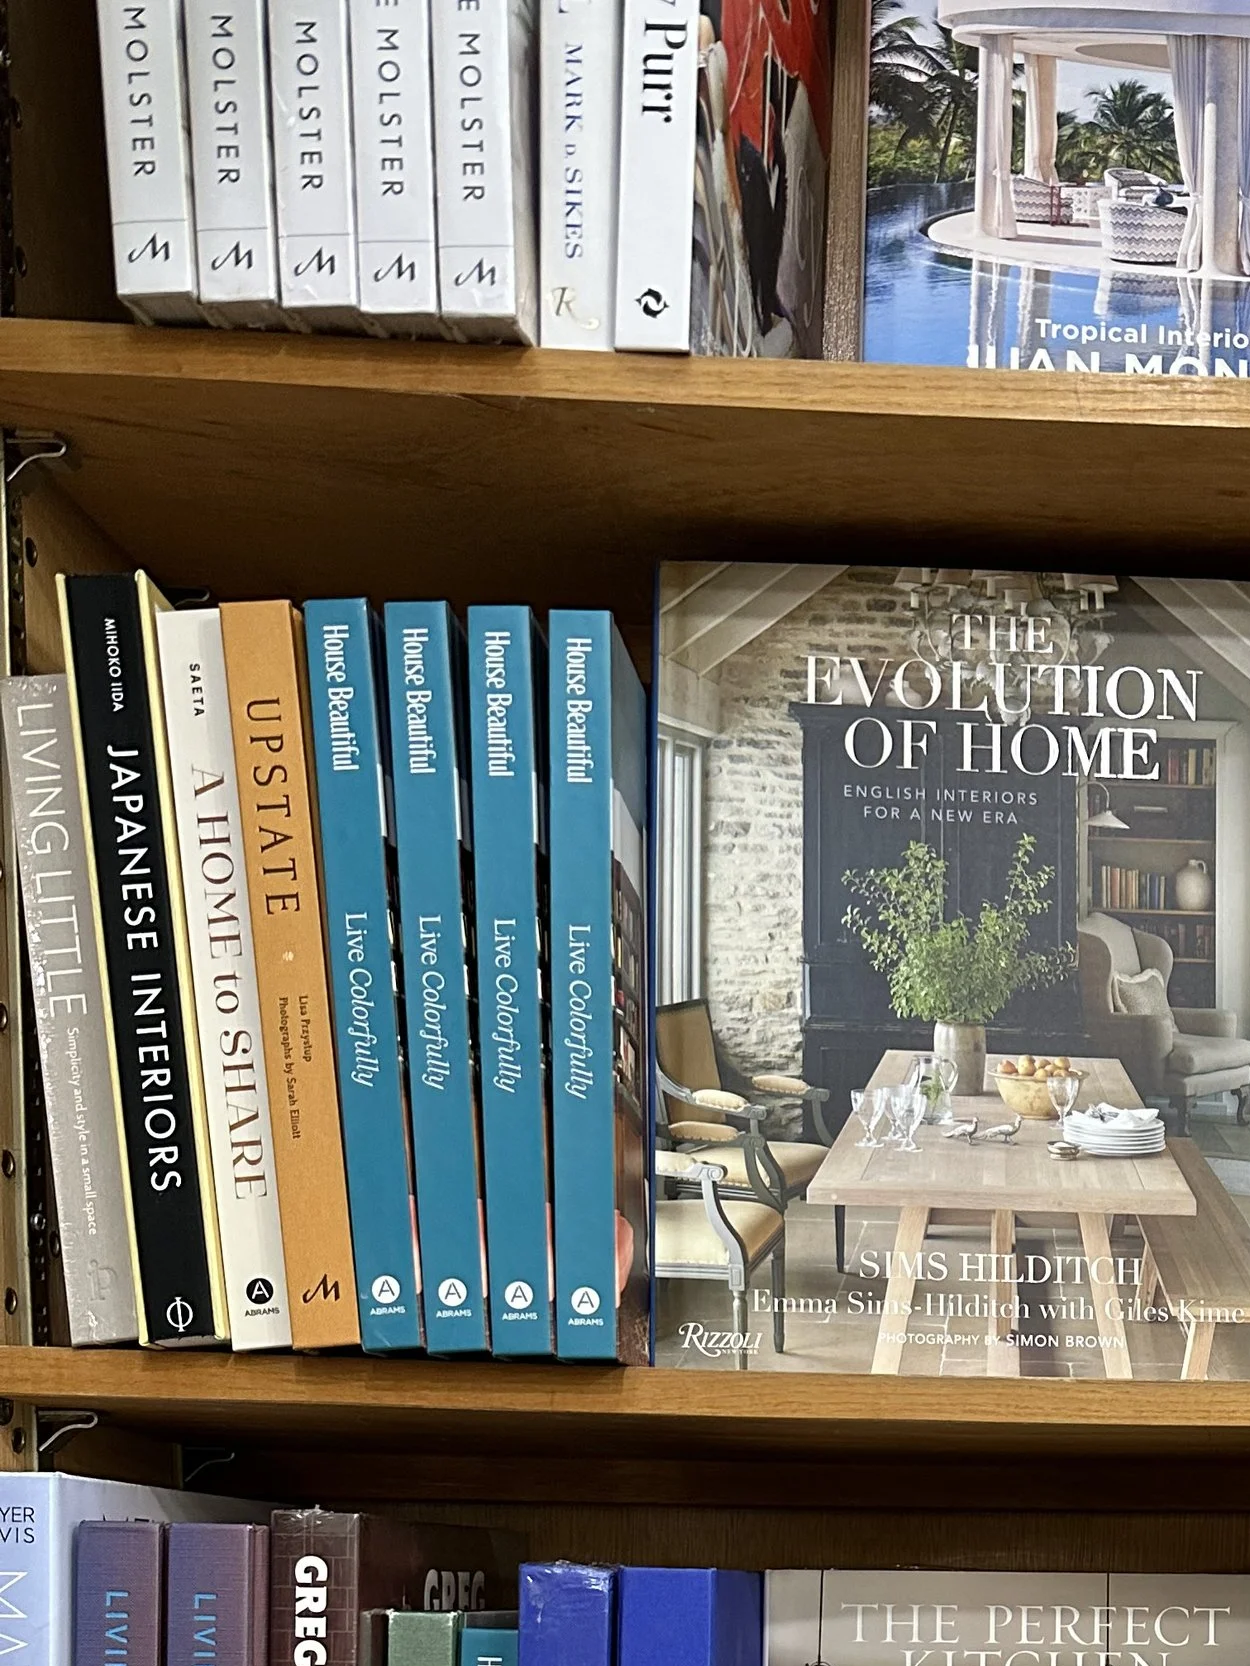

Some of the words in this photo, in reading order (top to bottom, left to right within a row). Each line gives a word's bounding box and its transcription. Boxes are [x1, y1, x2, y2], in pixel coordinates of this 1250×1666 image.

[564, 43, 584, 130] MARK
[641, 19, 688, 124] Purr
[459, 33, 485, 202] MOLSTER
[564, 166, 584, 259] SIKES
[1036, 318, 1149, 346] Tropical
[105, 618, 122, 677] MIHOKO
[952, 614, 1055, 654] THE
[190, 663, 205, 717] SAETA
[566, 638, 592, 695] House
[799, 655, 1203, 722] EVOLUTION
[111, 682, 124, 712] IIDA
[566, 700, 592, 783] Beautiful
[844, 717, 937, 771] OF
[956, 722, 1161, 782] HOME
[17, 703, 70, 855] LIVING
[192, 764, 225, 799] A
[247, 698, 300, 916] UPSTATE
[844, 785, 926, 800] ENGLISH
[937, 789, 1038, 805] INTERIORS
[864, 806, 900, 819] FOR
[910, 808, 921, 820] A
[932, 809, 973, 822] NEW
[983, 811, 1017, 824] ERA
[107, 745, 158, 950] JAPANESE
[196, 814, 243, 960] HOME
[35, 871, 87, 1016] LITTLE
[569, 924, 591, 973] Live
[213, 971, 243, 1014] to
[67, 1027, 84, 1085] Simplicity
[564, 979, 593, 1100] Colorfully
[73, 1087, 87, 1111] and
[130, 973, 182, 1192] INTERIORS
[73, 1113, 89, 1141] style
[219, 1028, 268, 1200] SHARE
[80, 1144, 88, 1156] in
[81, 1168, 97, 1199] small
[82, 1201, 97, 1235] space
[860, 1250, 948, 1281] SIMS
[959, 1252, 1142, 1286] HILDITCH
[879, 1332, 979, 1347] PHOTOGRAPHY
[984, 1334, 1000, 1347] BY
[1006, 1333, 1059, 1349] SIMON
[1066, 1335, 1125, 1349] BROWN
[840, 1602, 960, 1644] THE
[987, 1603, 1231, 1647] PERFECT
